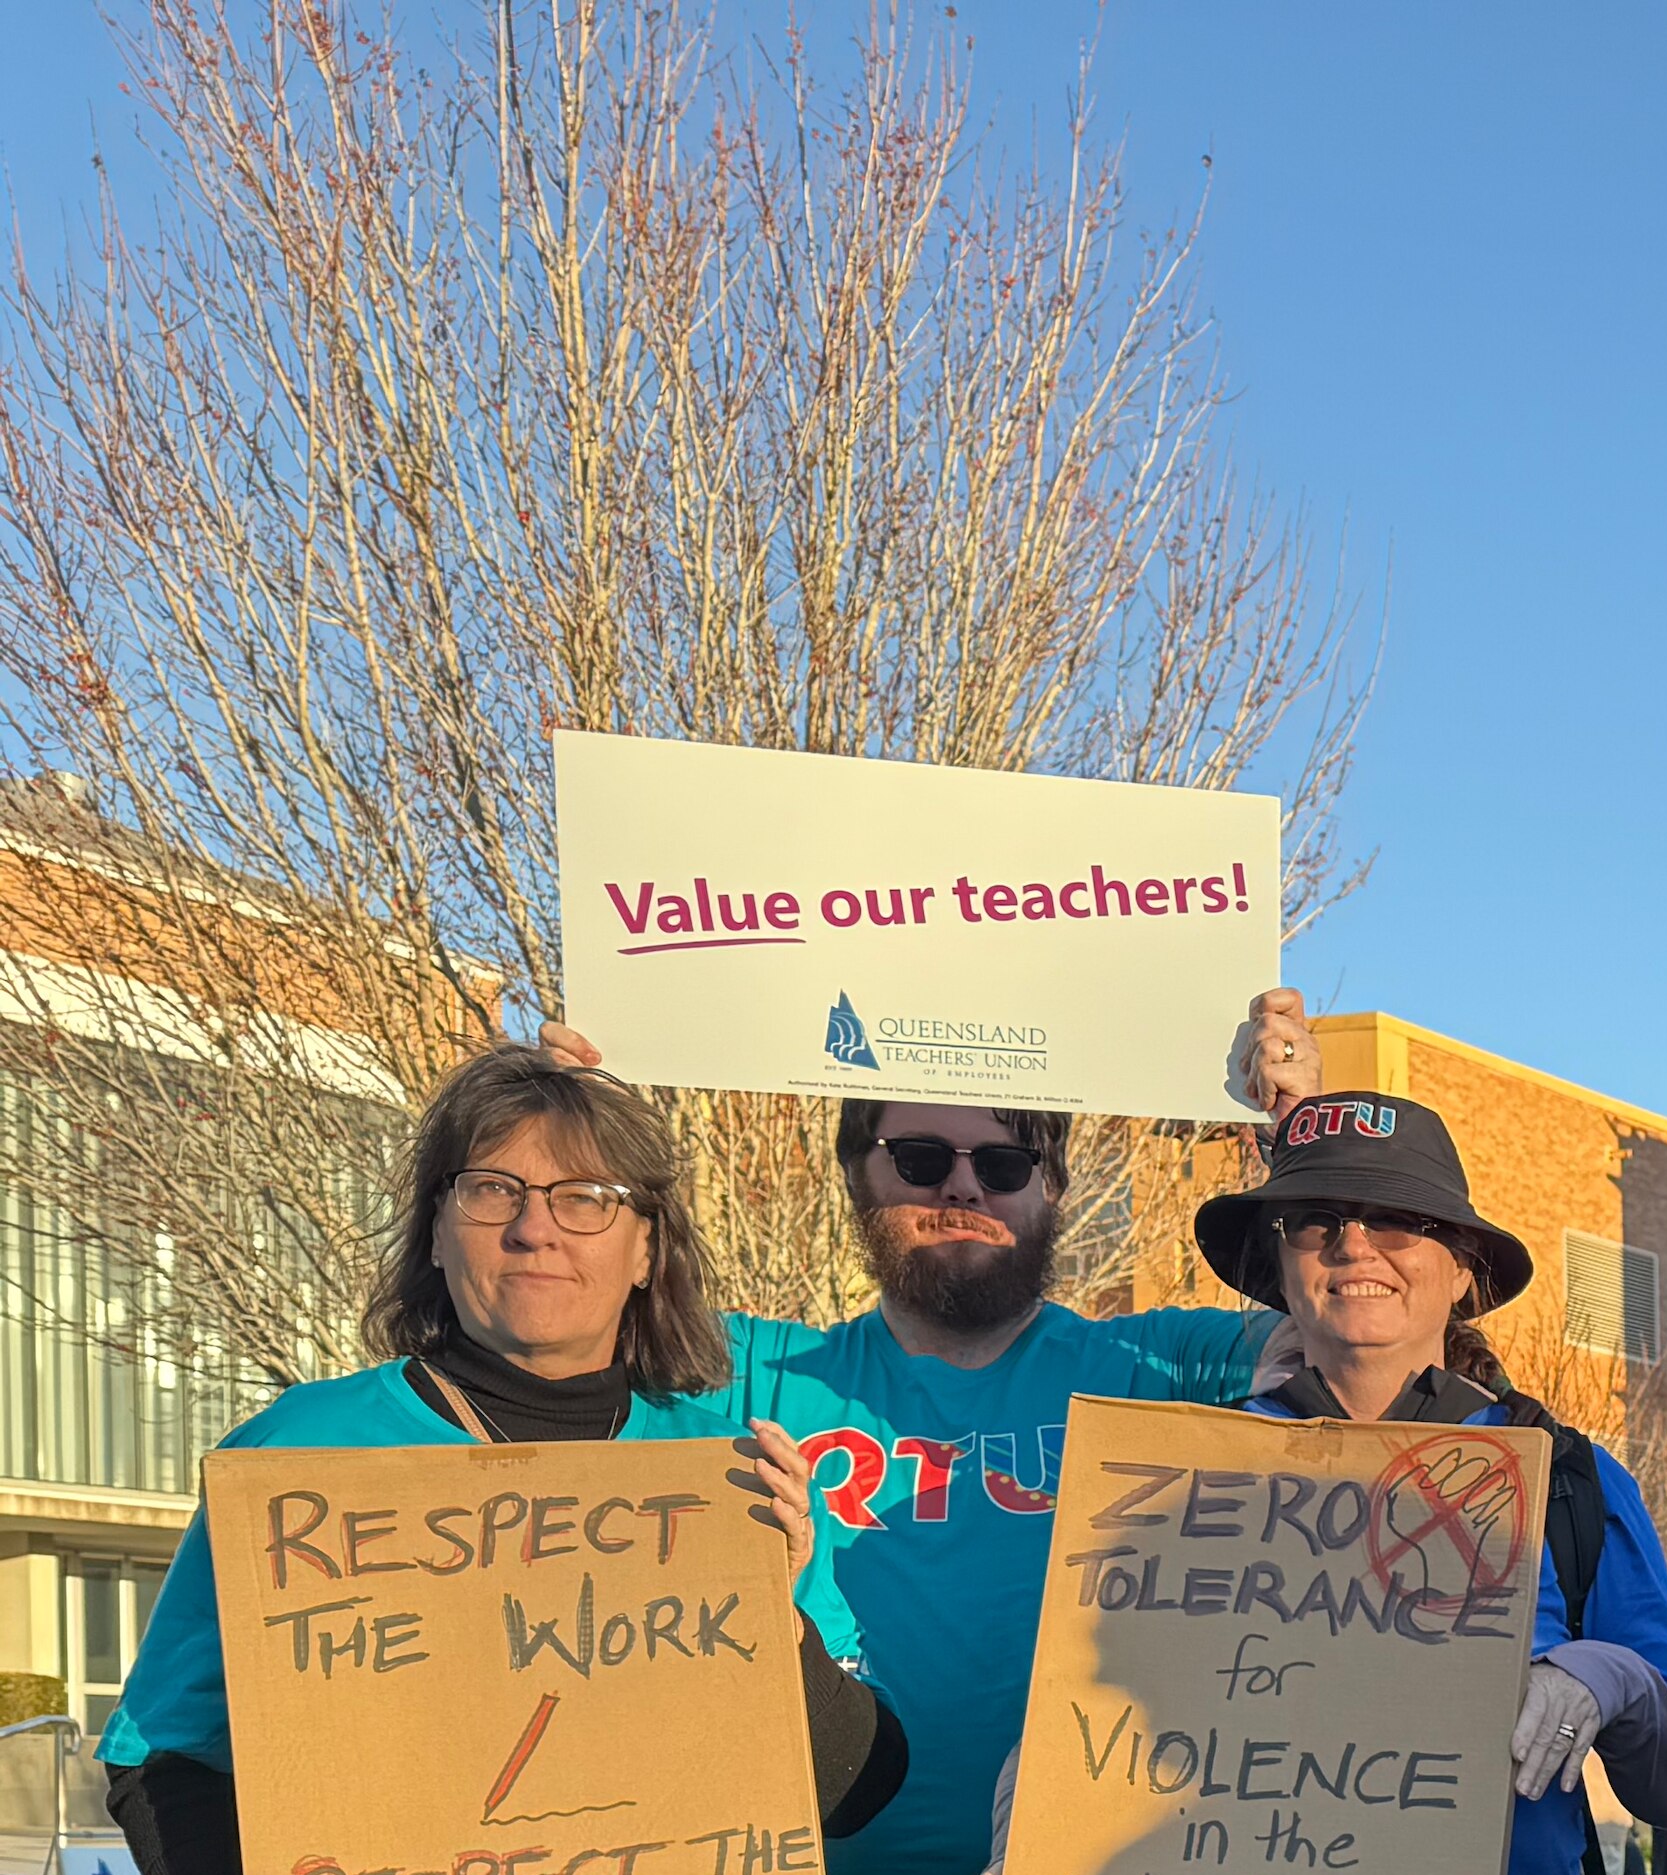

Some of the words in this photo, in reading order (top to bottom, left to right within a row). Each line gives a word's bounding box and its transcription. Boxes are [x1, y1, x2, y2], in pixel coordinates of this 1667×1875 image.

[604, 876, 801, 936] Value
[820, 884, 937, 928] our
[951, 862, 1250, 924] teachers!
[879, 1017, 1048, 1047] QUEENSLAND
[882, 1046, 978, 1067] TEACHERS'
[984, 1053, 1048, 1071] UNION
[923, 1068, 938, 1076] OF
[947, 1070, 1011, 1081] EMPLOYEES
[1287, 1101, 1397, 1146] QTU
[797, 1424, 1066, 1531] QTU
[1088, 1460, 1371, 1556] ZERO
[267, 1489, 710, 1590] RESPECT
[264, 1597, 430, 1680] THE
[502, 1571, 757, 1679] WORK
[1065, 1545, 1519, 1645] TOLERANCE
[1216, 1634, 1315, 1700] for
[1070, 1701, 1462, 1810] VIOLENCE
[1181, 1808, 1228, 1864] in
[1255, 1809, 1360, 1869] the
